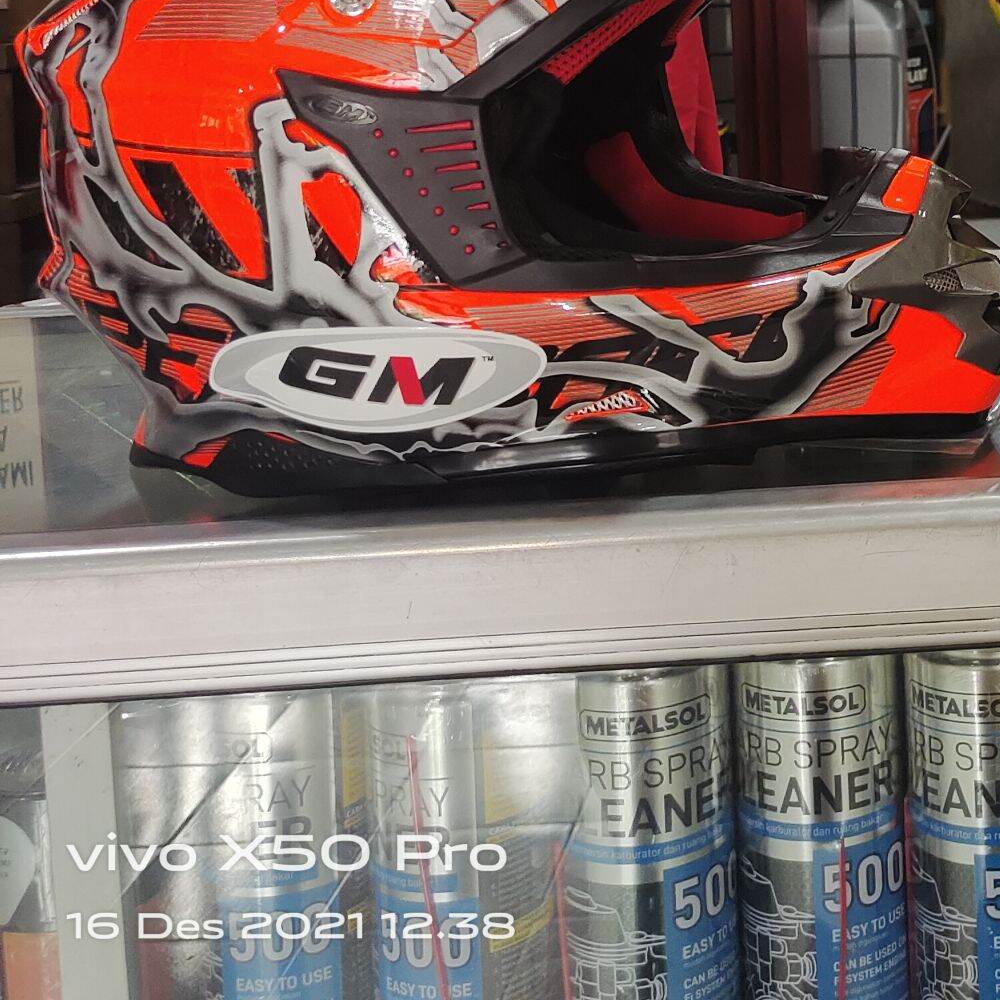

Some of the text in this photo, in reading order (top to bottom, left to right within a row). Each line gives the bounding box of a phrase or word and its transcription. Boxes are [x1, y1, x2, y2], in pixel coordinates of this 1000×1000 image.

[278, 346, 475, 406] GM
[745, 689, 860, 716] METALSOL
[586, 702, 706, 736] METALSOL
[793, 721, 892, 769] SPRAY
[823, 840, 904, 914] 500
[871, 916, 886, 933] TO
[682, 932, 716, 960] EASY
[859, 954, 872, 967] BE
[875, 941, 897, 961] USED
[236, 966, 333, 992] EASY TO USE
[683, 972, 706, 989] CAN
[845, 964, 882, 985] SYSTEM
[387, 977, 418, 997] EASY
[418, 981, 437, 999] TO
